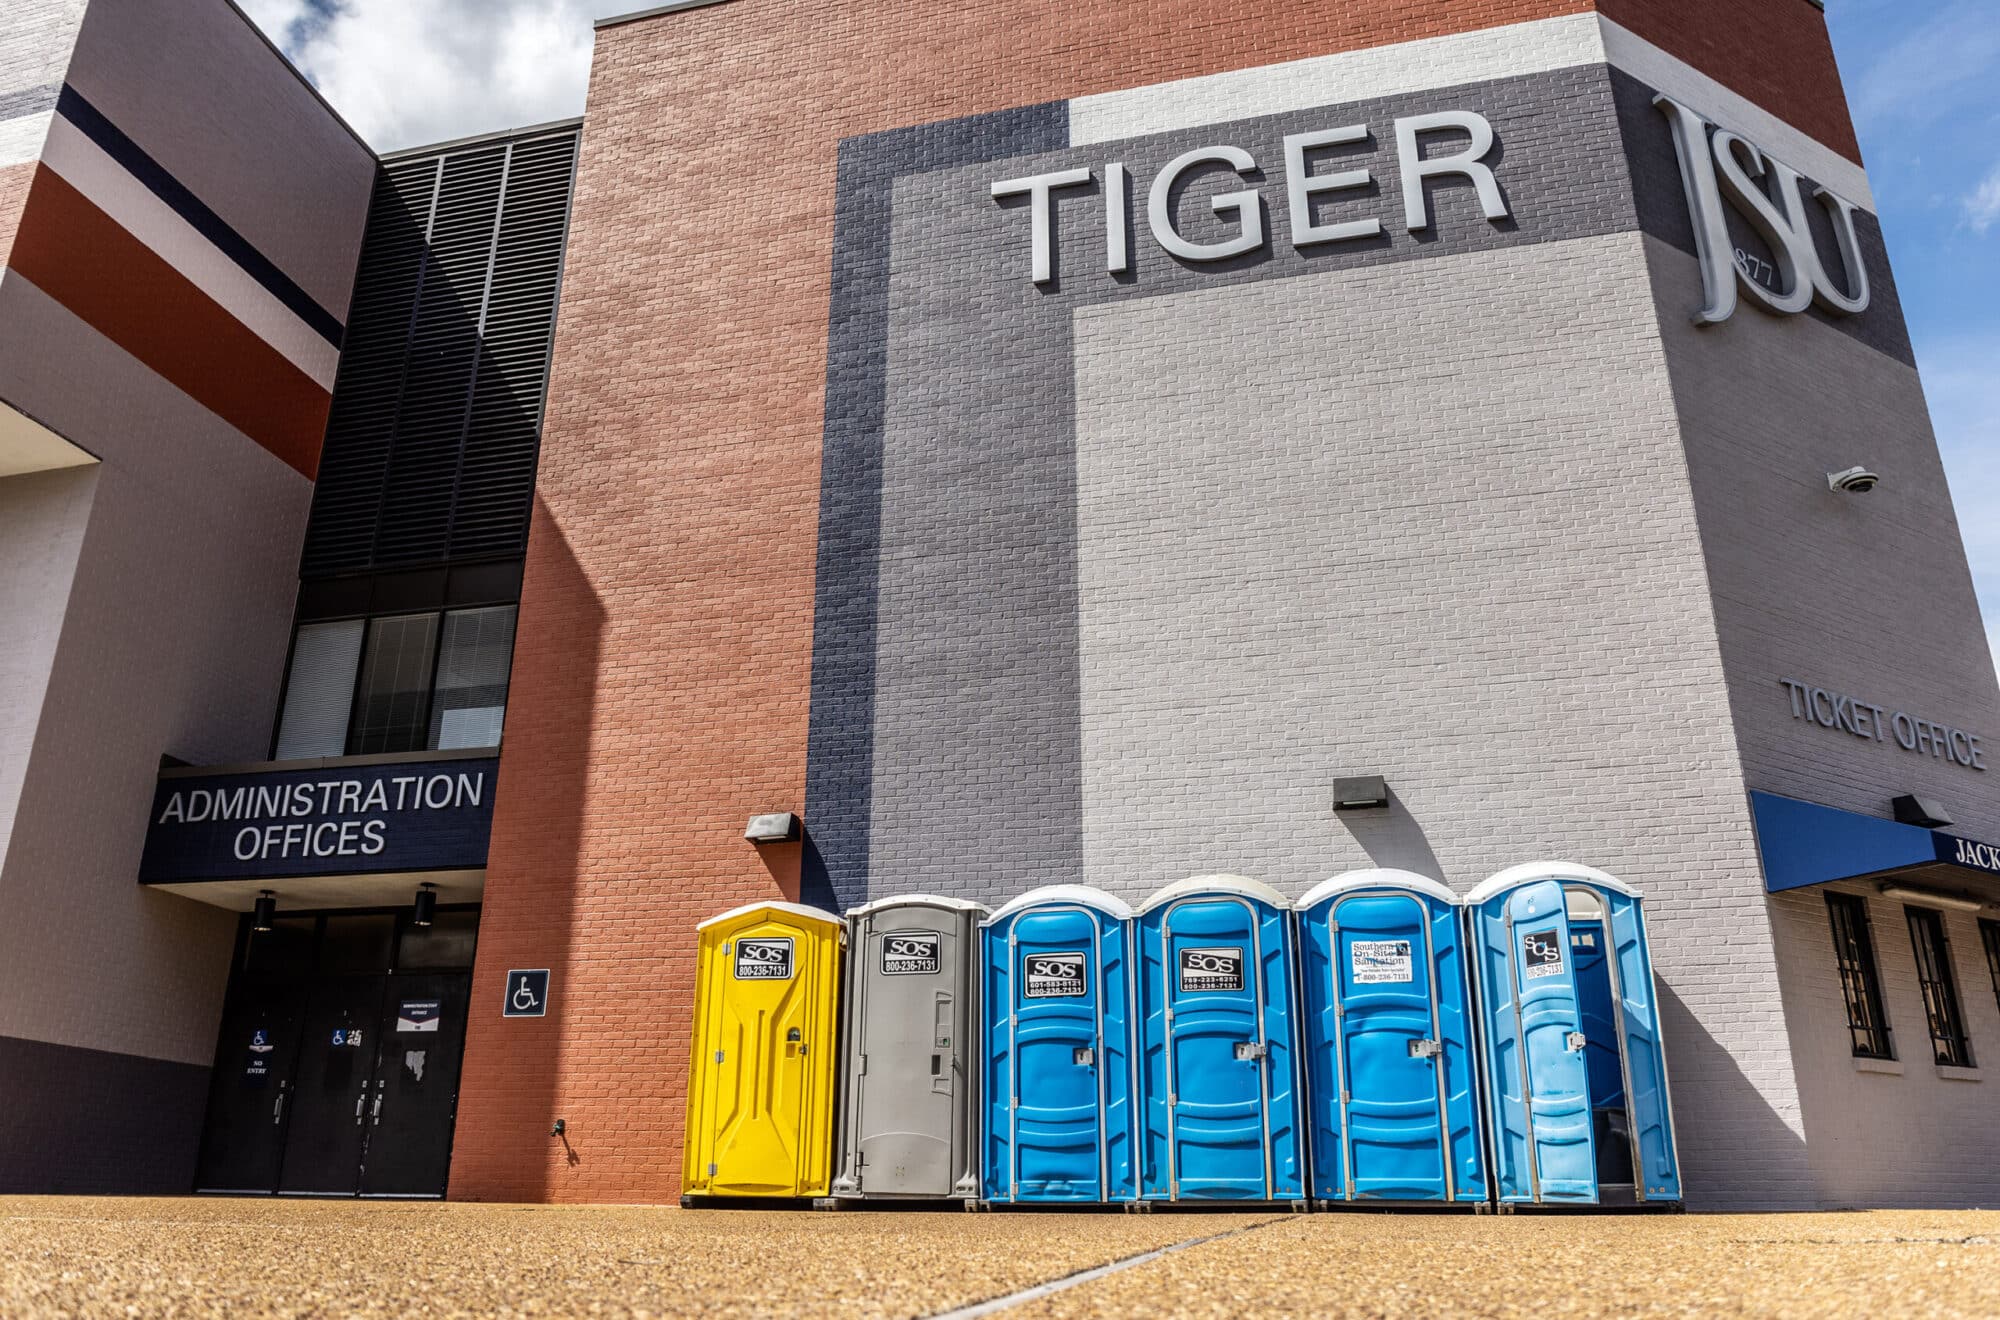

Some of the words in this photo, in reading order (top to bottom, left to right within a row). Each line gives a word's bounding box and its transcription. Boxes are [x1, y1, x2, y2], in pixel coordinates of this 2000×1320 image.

[991, 110, 1508, 284] TIGER
[1652, 92, 1870, 327] JSU
[1779, 677, 1884, 742] TICKET
[1891, 710, 1986, 771] OFFICE
[159, 772, 484, 824] ADMINISTRATION
[233, 819, 386, 861] OFFICES
[1955, 838, 2000, 871] JACK
[744, 945, 783, 963] SOS
[891, 940, 931, 957] SOS
[1353, 943, 1394, 951] Southern
[1525, 935, 1559, 962] SOS
[739, 965, 786, 976] 800-236-7131
[885, 959, 936, 972] 800-236-7131
[1034, 961, 1077, 978] SOS
[1188, 953, 1234, 973] SOS
